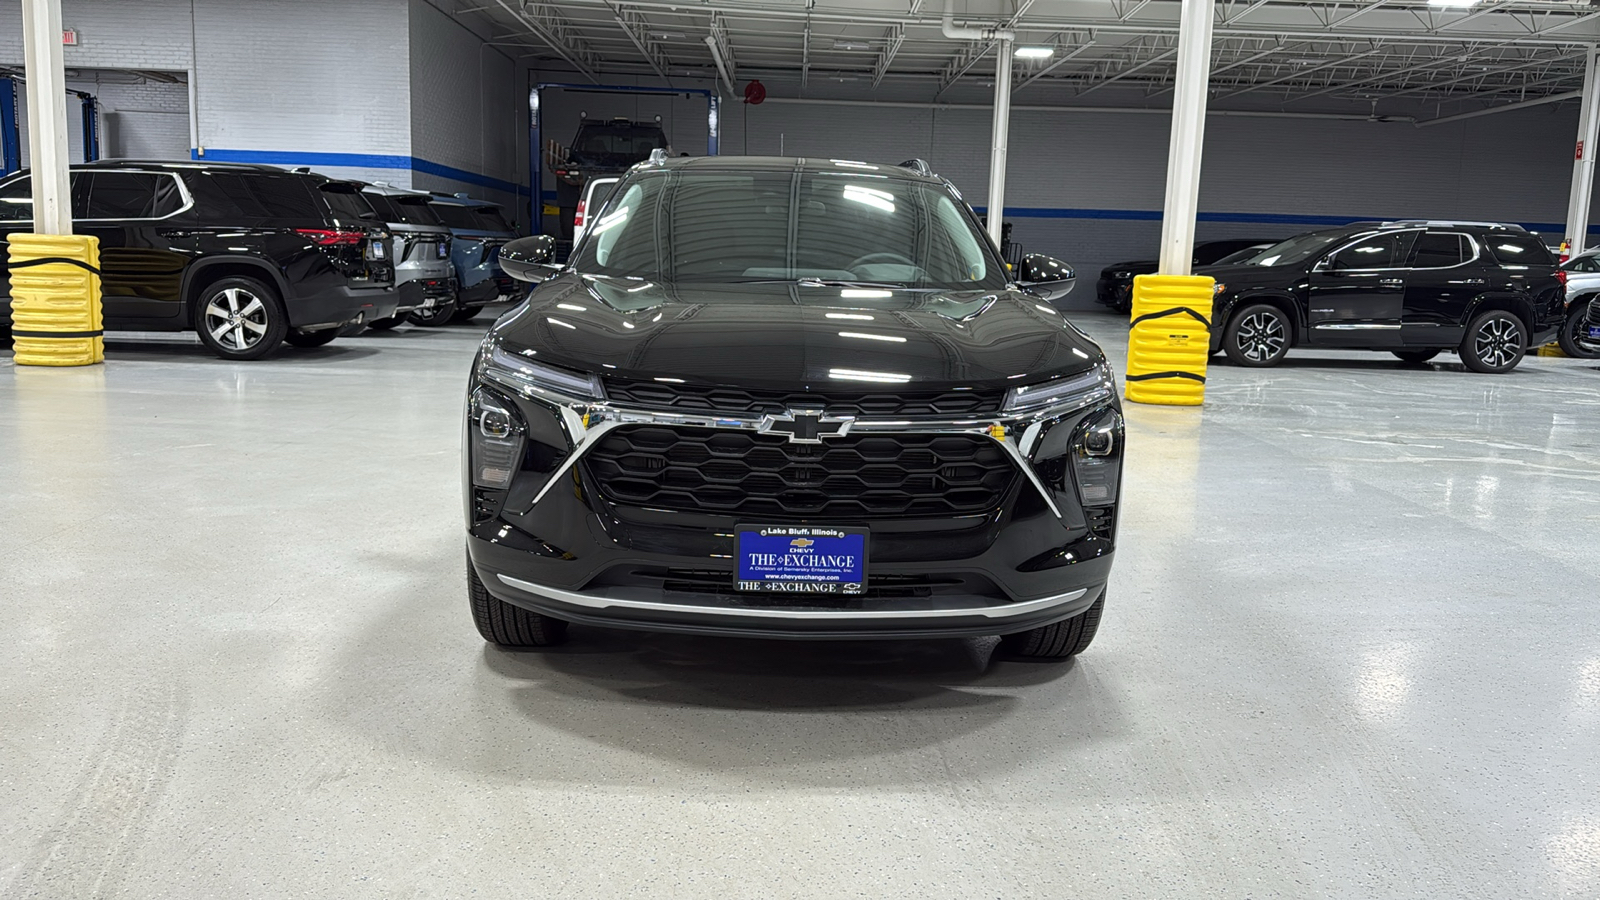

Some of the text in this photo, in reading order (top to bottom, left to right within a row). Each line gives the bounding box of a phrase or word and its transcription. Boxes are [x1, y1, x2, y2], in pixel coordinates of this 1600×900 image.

[63, 32, 74, 43] XIT
[768, 527, 786, 535] Lake
[788, 528, 810, 536] Bluff,
[749, 553, 854, 568] THE EXCHANGE
[738, 581, 836, 593] THE EXCHANGE
